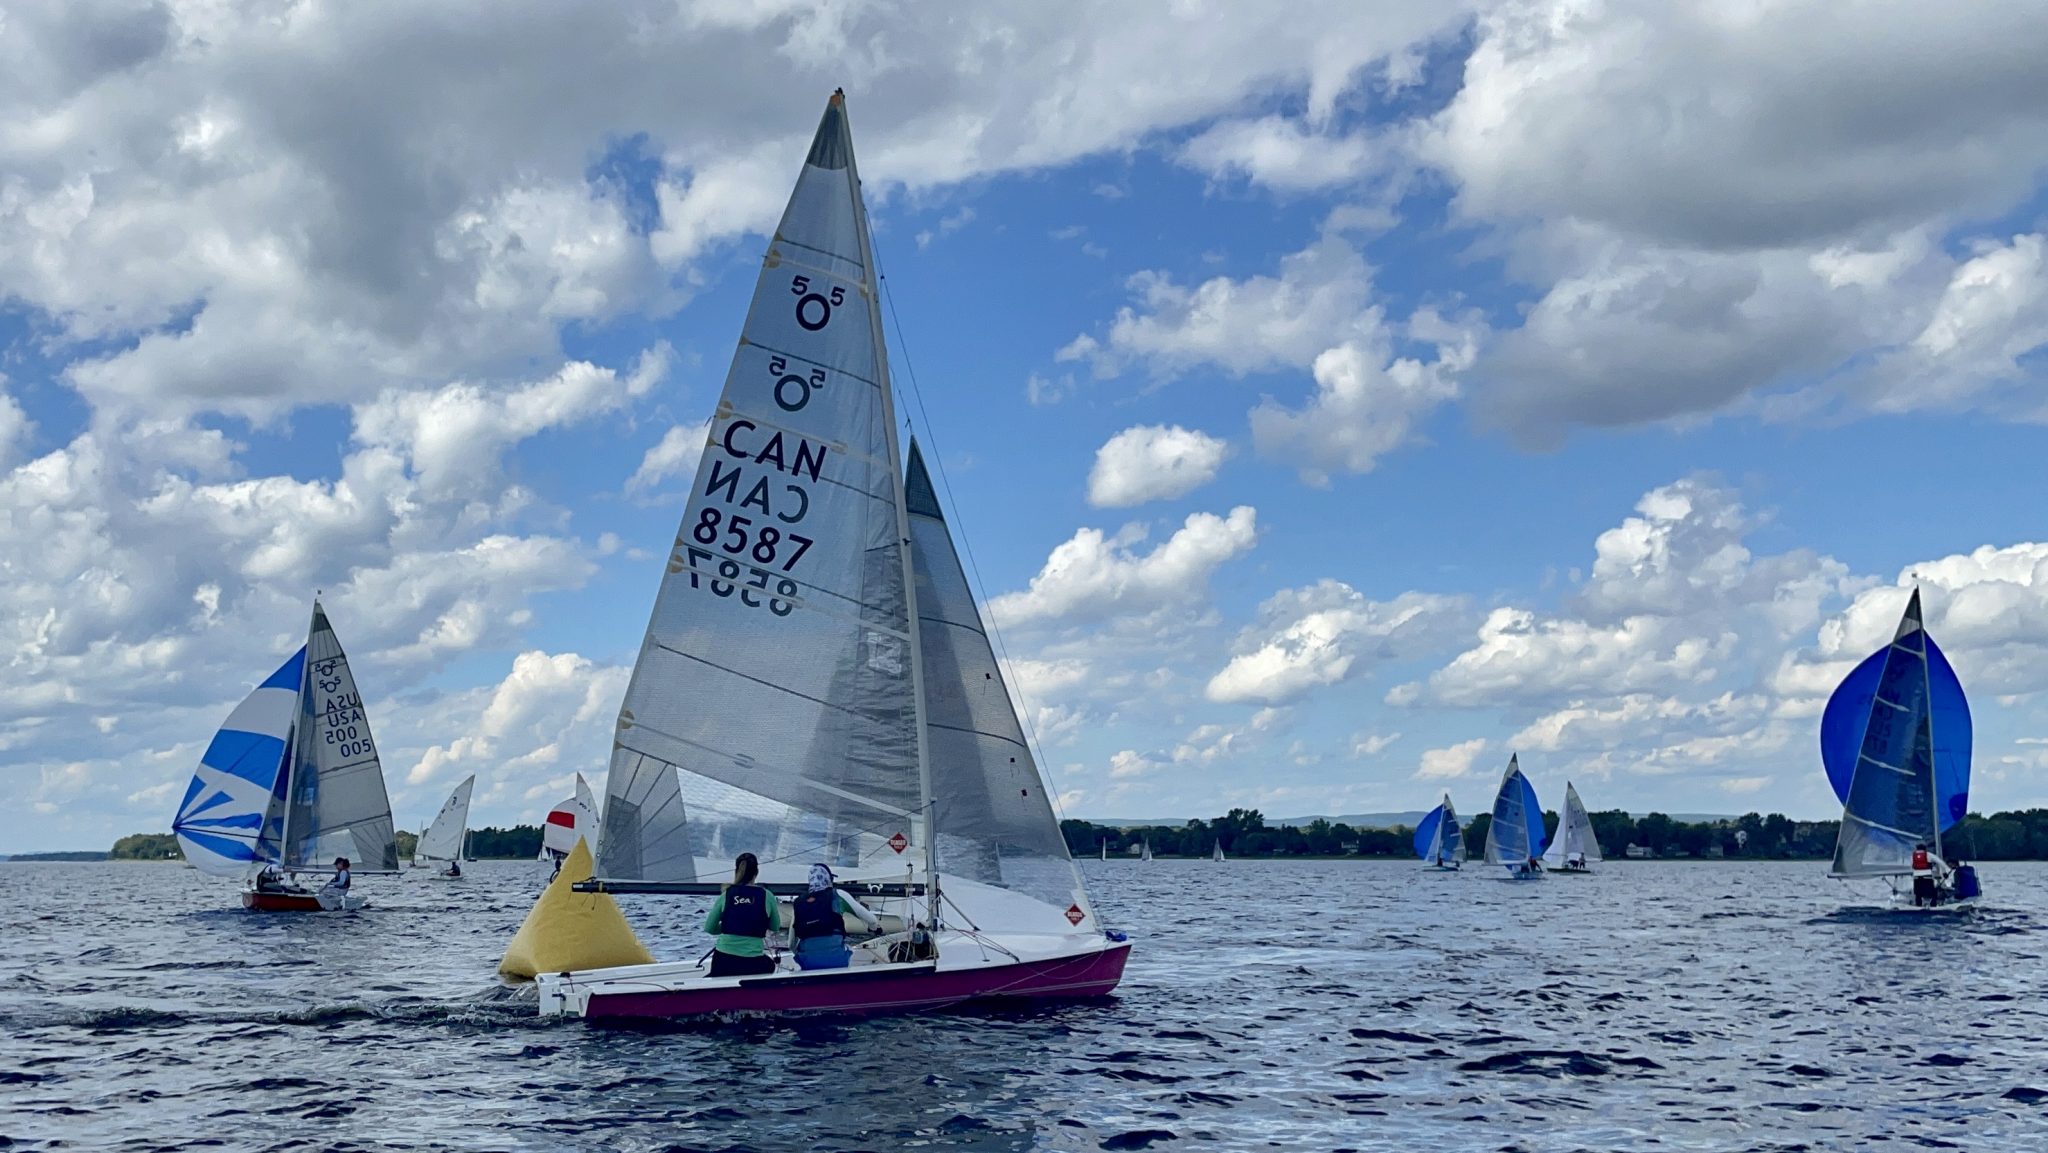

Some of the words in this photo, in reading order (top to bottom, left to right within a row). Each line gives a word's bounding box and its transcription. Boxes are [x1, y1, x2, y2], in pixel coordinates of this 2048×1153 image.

[723, 420, 827, 483] CAN
[693, 507, 814, 572] 8587
[328, 709, 362, 728] USA
[340, 739, 372, 758] 005
